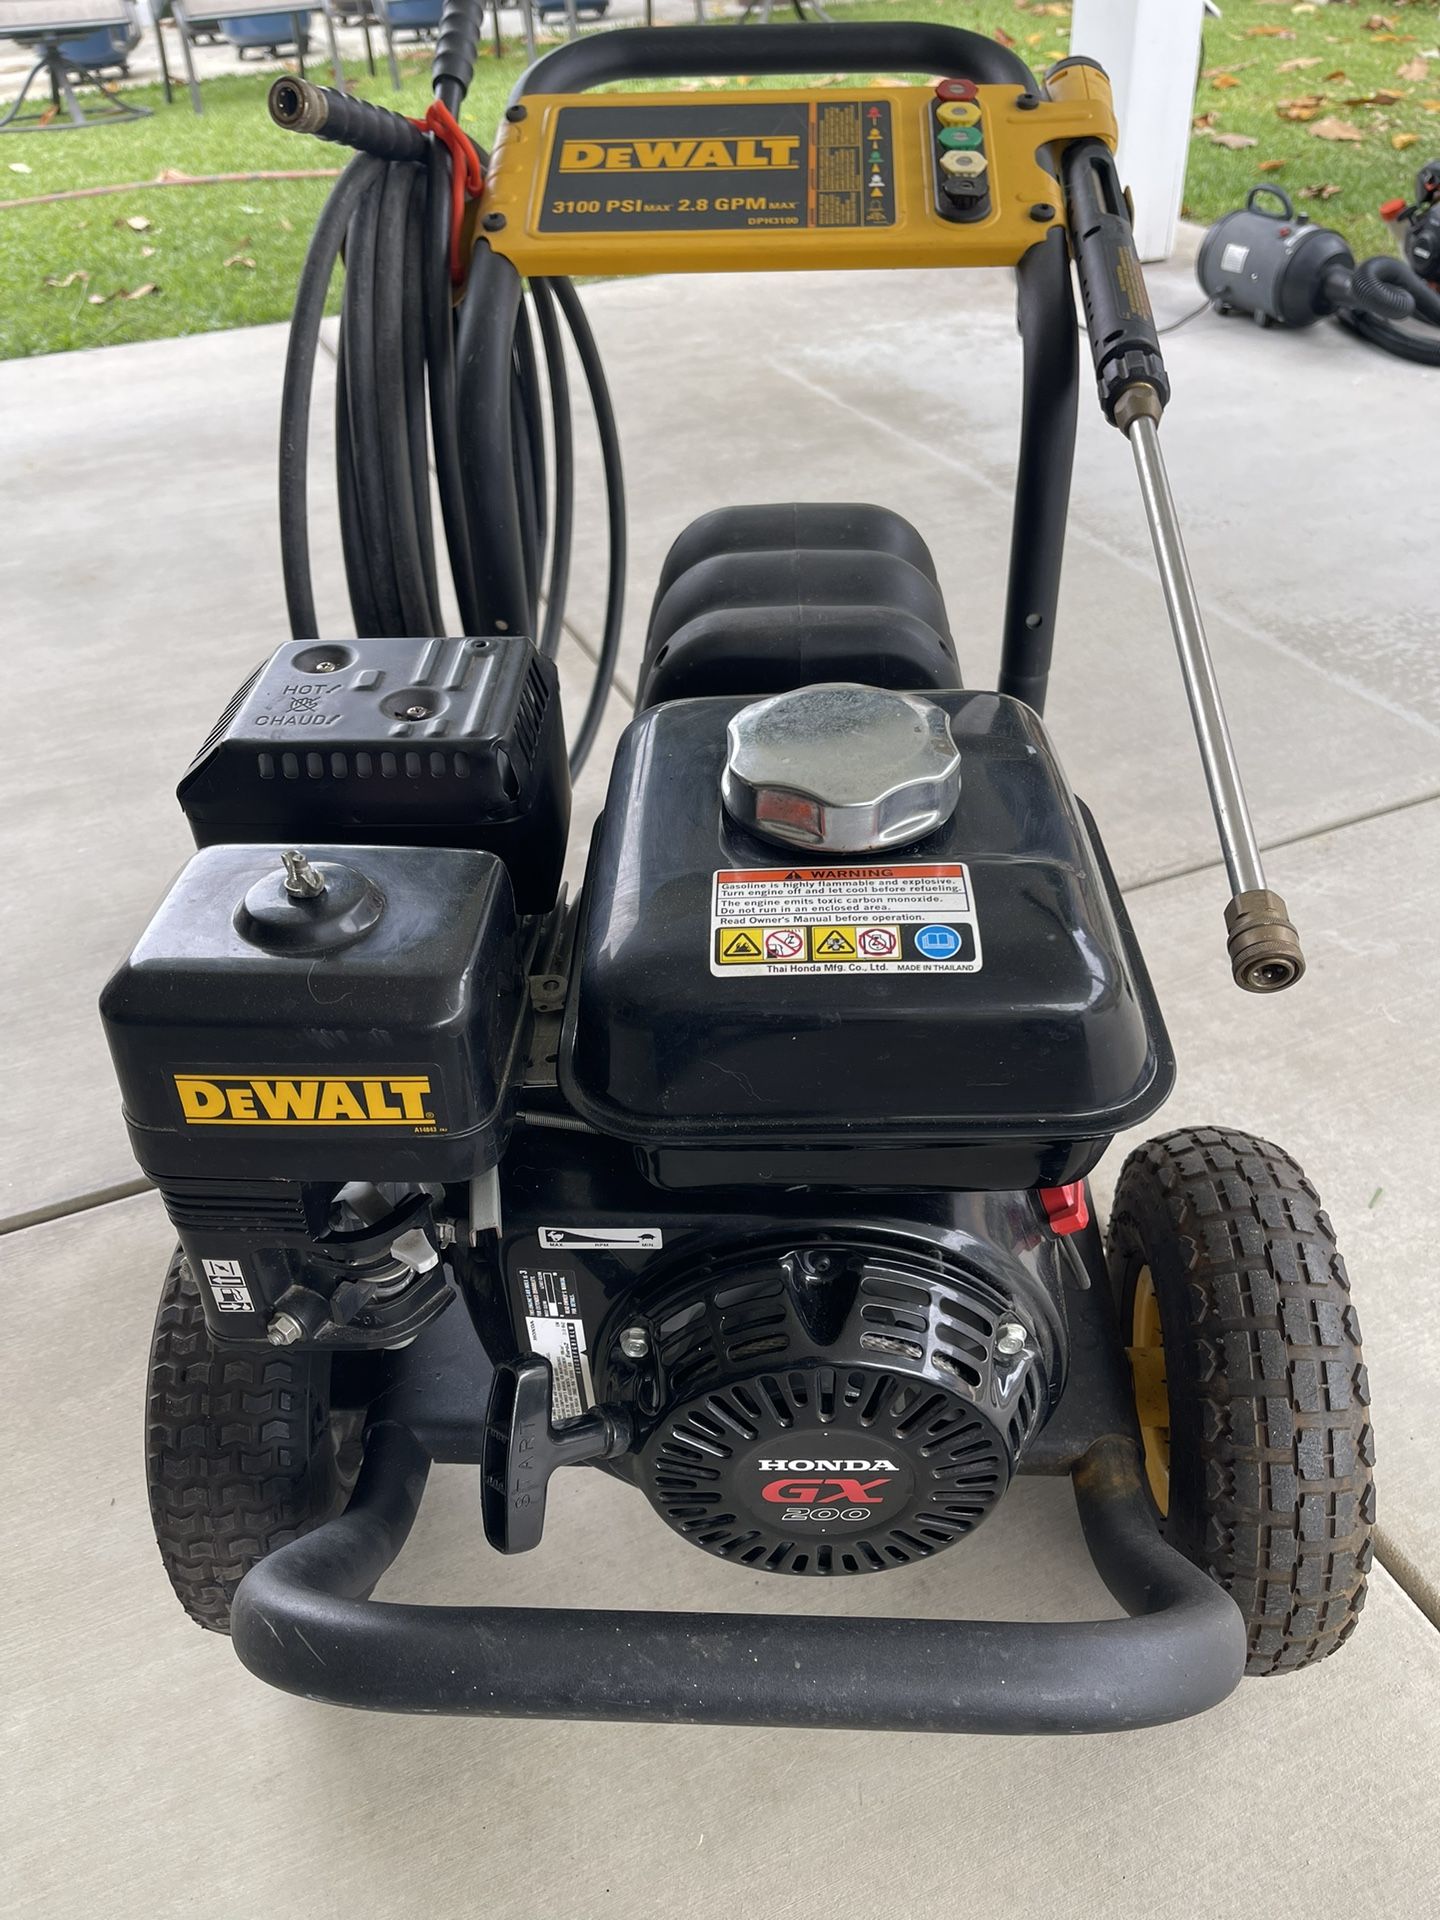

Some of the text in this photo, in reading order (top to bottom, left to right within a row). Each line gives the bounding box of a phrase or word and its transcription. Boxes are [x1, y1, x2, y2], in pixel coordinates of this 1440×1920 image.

[552, 200, 600, 214] 3100
[606, 199, 642, 213] PSI
[677, 198, 708, 213] 2.8
[714, 197, 767, 212] GPM
[747, 216, 799, 226] DPH3100
[811, 869, 894, 879] WARNING
[783, 881, 815, 889] highly
[818, 879, 875, 888] flammable
[902, 878, 956, 886] explosive.
[748, 889, 784, 897] engine
[787, 887, 801, 895] off
[846, 886, 868, 894] cool
[872, 885, 906, 893] before
[909, 885, 962, 893] refueling.
[744, 899, 781, 907] engine
[846, 896, 882, 904] carbon
[887, 895, 943, 903] monoxide.
[720, 913, 925, 925] Read Owner's Manual before operation.
[767, 965, 788, 973] Thai
[790, 964, 822, 973] Honda
[824, 964, 846, 973] Mfg.
[848, 963, 868, 973] Co.,
[870, 963, 889, 972] Ltd.
[515, 1422, 536, 1509] START
[758, 1459, 900, 1471] HONDA
[762, 1478, 893, 1503] GX
[781, 1507, 871, 1521] 200
